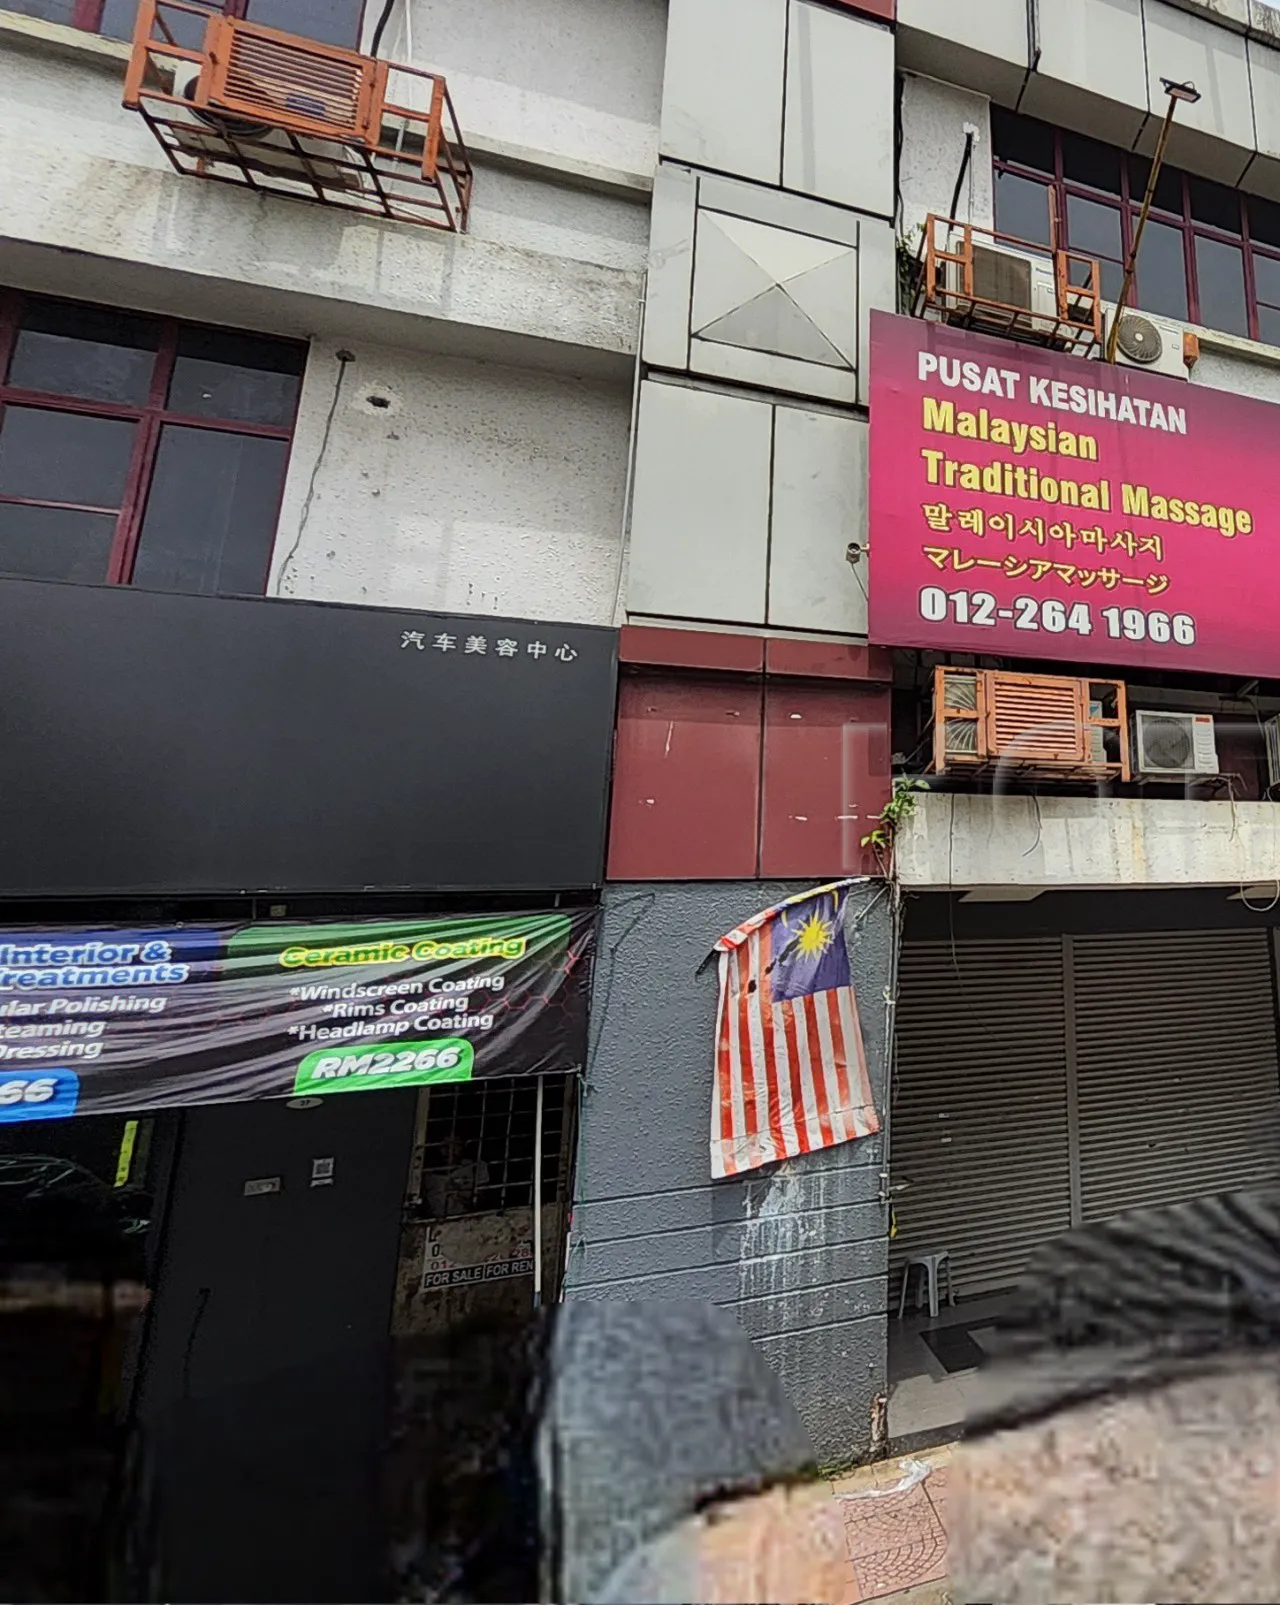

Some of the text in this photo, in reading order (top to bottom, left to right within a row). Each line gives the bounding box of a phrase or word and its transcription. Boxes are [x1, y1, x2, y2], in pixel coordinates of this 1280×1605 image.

[918, 352, 1187, 434] PUSAT KESIHATAN
[922, 396, 1098, 461] Malaysian
[920, 449, 1254, 538] Traditional Massage
[922, 503, 1163, 562] 말레이시아마사지
[922, 546, 1169, 596] マレーシアマッサージ
[919, 586, 1197, 646] 012-264 1966
[400, 630, 578, 662] 汽车美容中心
[0, 941, 172, 967] Interior &
[279, 935, 526, 968] Ceramic Coating
[0, 963, 189, 990] reatments
[428, 974, 505, 993] Coating
[47, 995, 168, 1015] Polishing
[390, 995, 469, 1016] Coating
[413, 1012, 494, 1032] Coating
[311, 1046, 464, 1080] RM2266
[425, 1272, 450, 1287] FOR
[451, 1265, 482, 1283] SALE
[485, 1262, 509, 1278] FOR
[511, 1258, 535, 1274] REN
